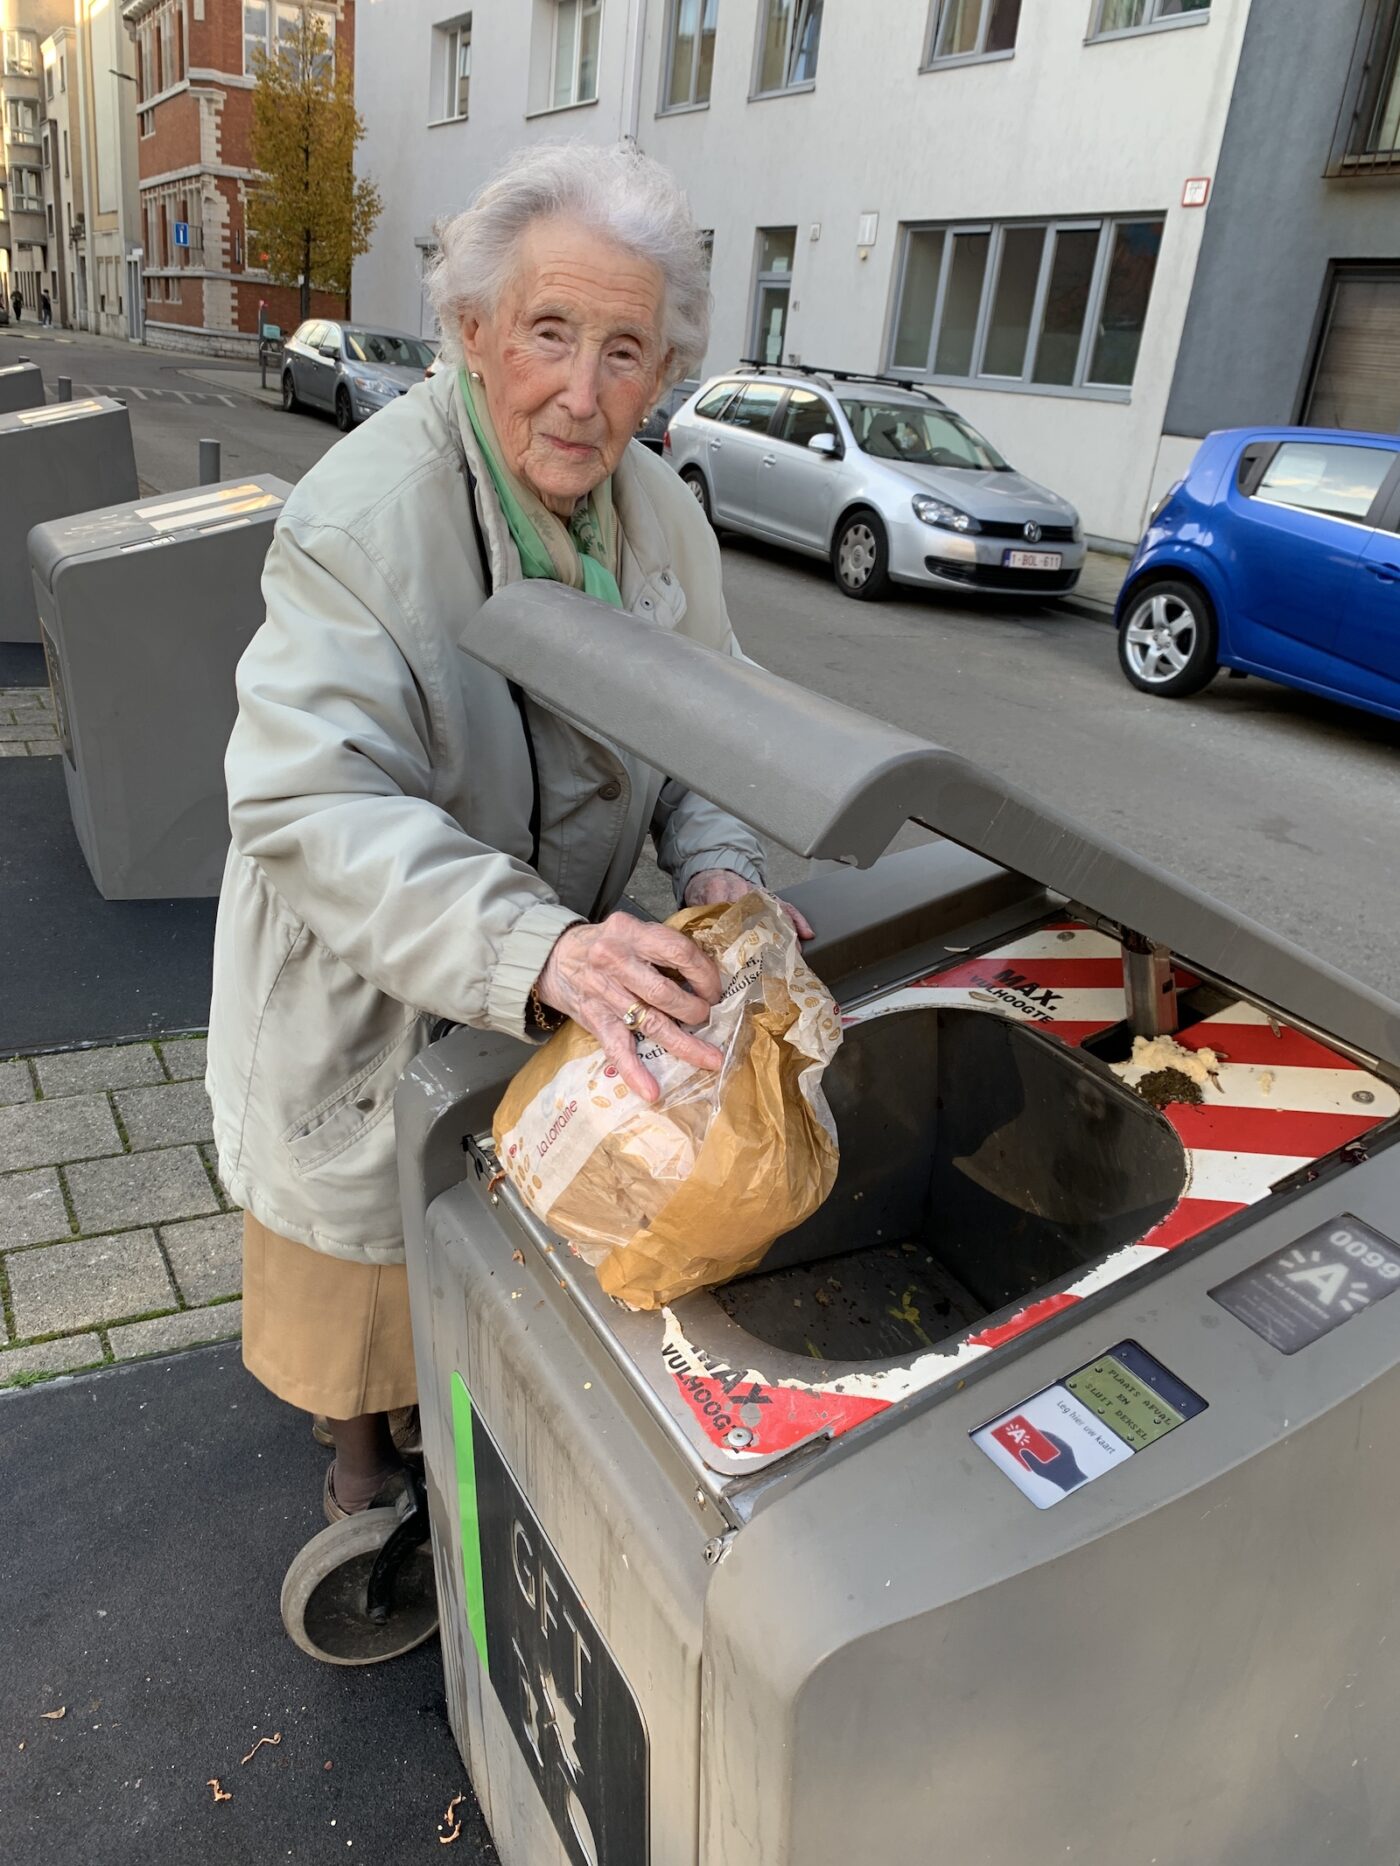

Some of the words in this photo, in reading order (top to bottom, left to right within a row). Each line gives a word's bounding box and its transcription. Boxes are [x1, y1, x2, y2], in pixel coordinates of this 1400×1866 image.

[970, 975, 1054, 1024] VULHOOGTE
[1329, 1230, 1400, 1279] 0099
[661, 1342, 753, 1454] VULHOOG
[1084, 1382, 1115, 1409] SLUIT
[1114, 1408, 1149, 1442] DEKSEL
[1107, 1368, 1141, 1398] PLAATS
[1142, 1399, 1173, 1426] AFVAL
[1116, 1392, 1131, 1405] EN
[1056, 1399, 1070, 1414] Leg
[1069, 1409, 1085, 1427] hier
[1083, 1424, 1096, 1438] uw
[1095, 1434, 1116, 1455] kaart
[511, 1518, 592, 1707] GFT
